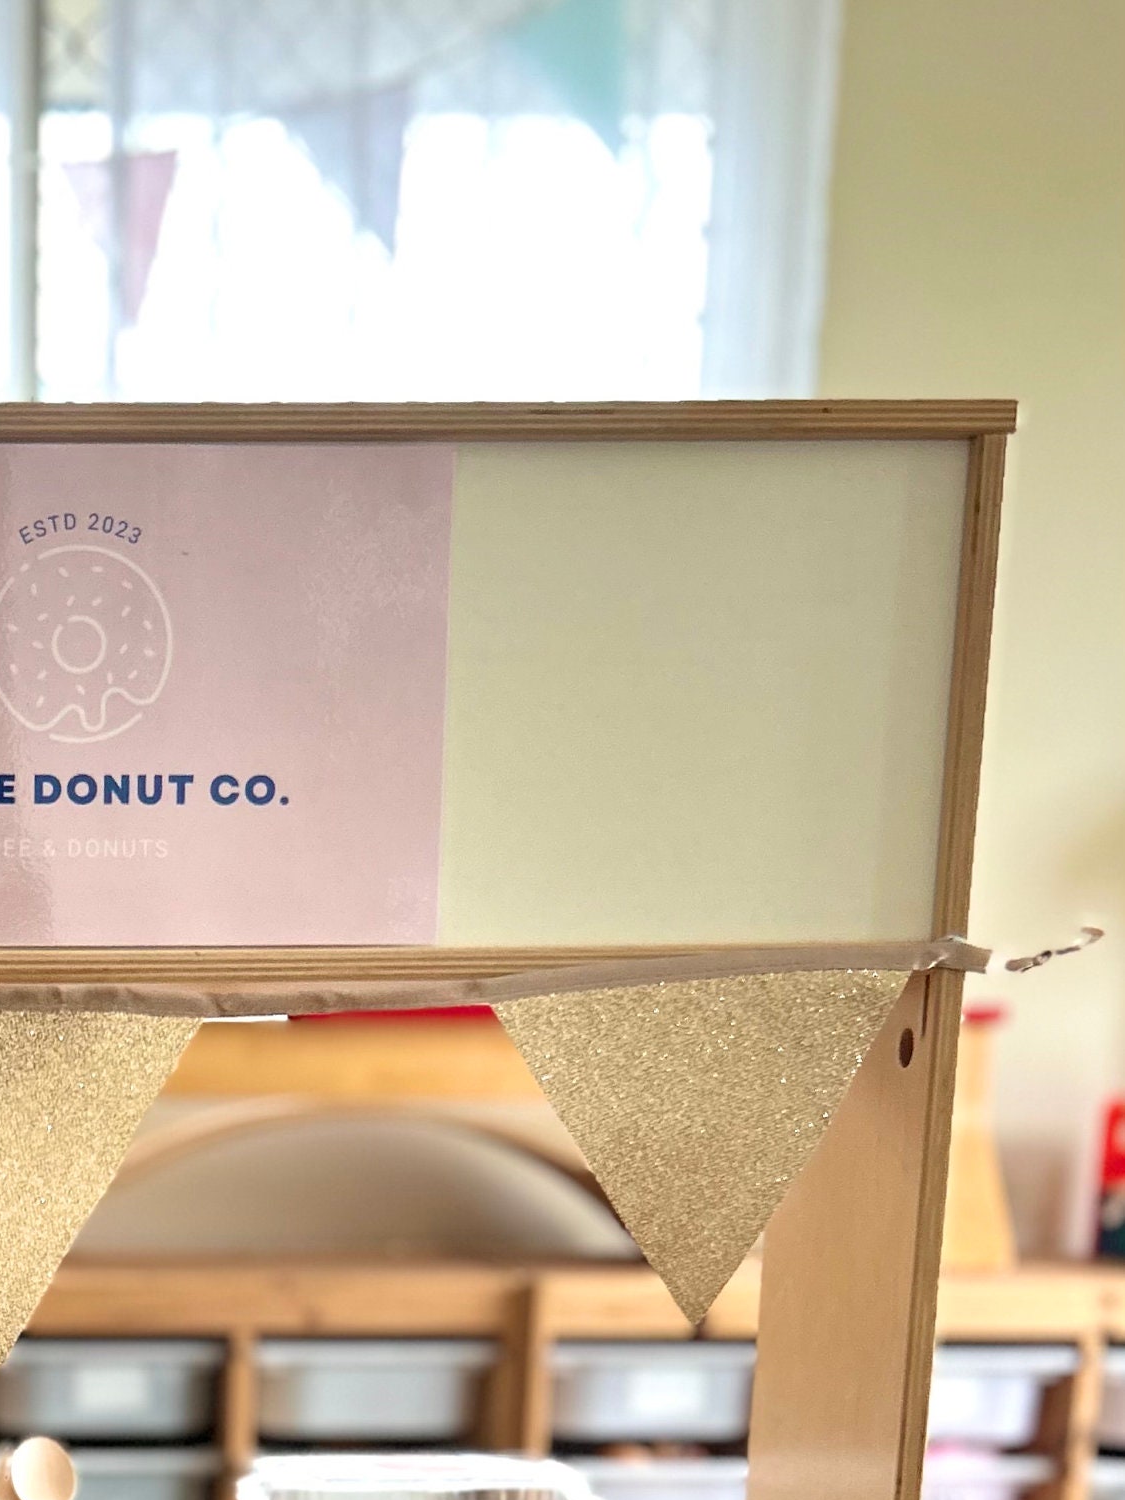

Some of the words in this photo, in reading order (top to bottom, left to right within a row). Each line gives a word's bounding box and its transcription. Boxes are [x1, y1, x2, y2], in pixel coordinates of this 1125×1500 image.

[18, 512, 77, 545] ESTD
[87, 512, 143, 545] 2023
[33, 773, 195, 806] DONUT
[209, 774, 290, 806] CO.
[42, 838, 58, 859] &
[66, 838, 170, 861] DONUTS
